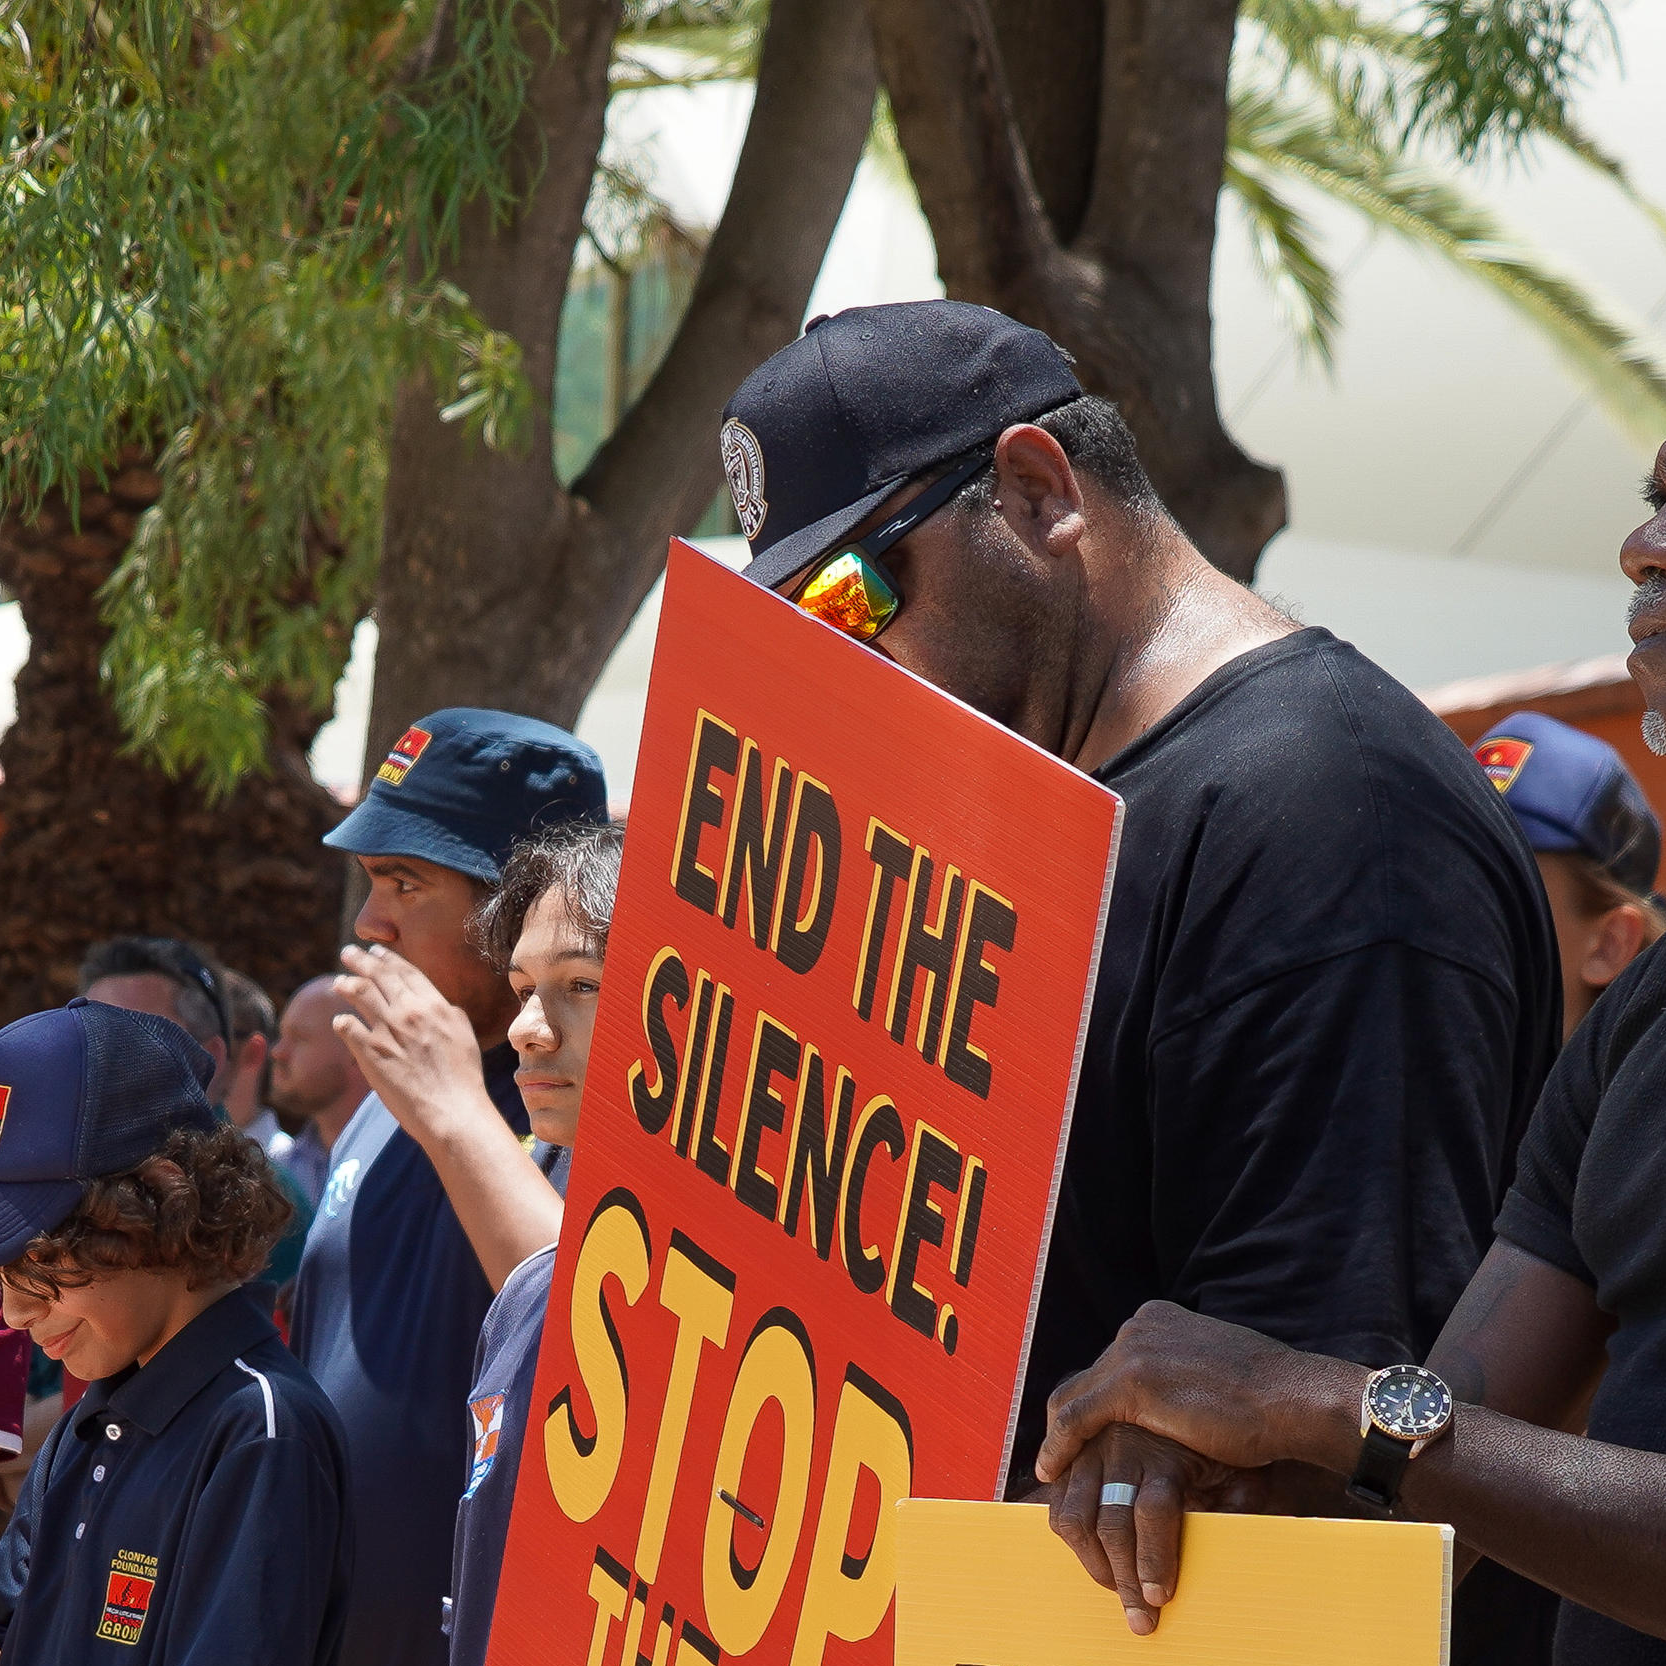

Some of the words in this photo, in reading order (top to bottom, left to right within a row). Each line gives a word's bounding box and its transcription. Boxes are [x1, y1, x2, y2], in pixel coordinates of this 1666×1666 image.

[670, 707, 842, 975] END
[852, 815, 1016, 1100] THE
[627, 946, 987, 1356] SILENCE!
